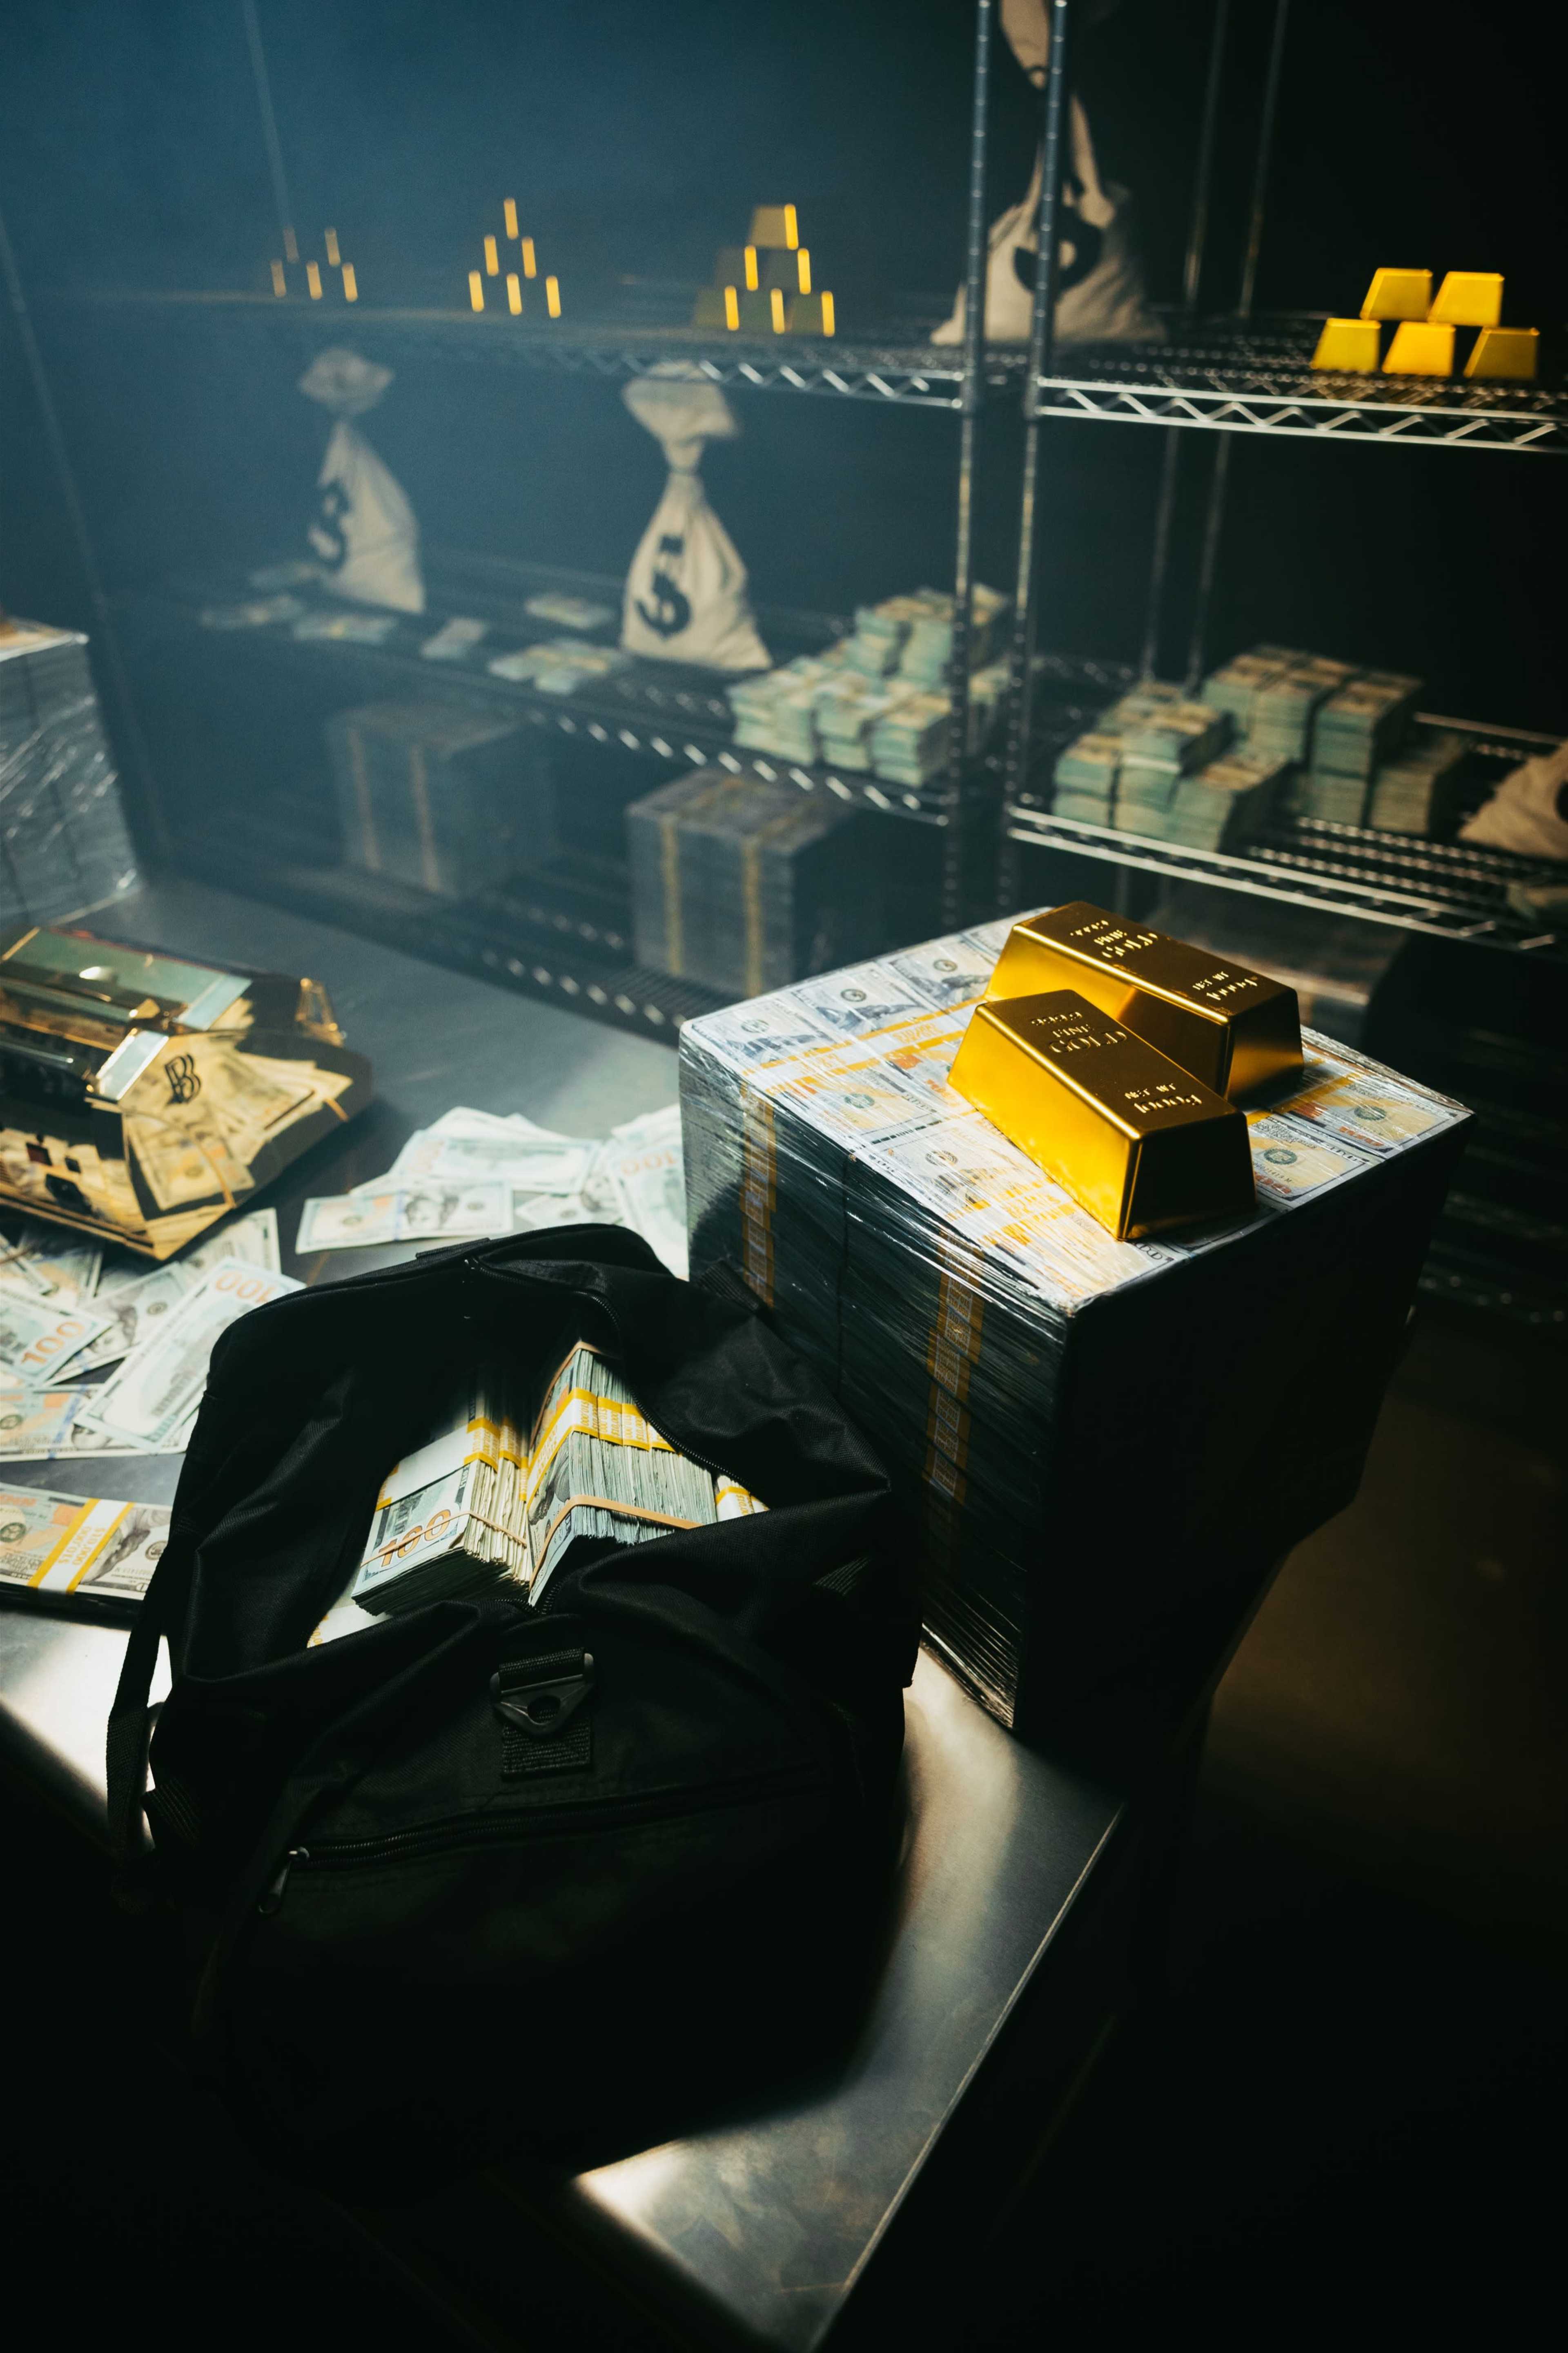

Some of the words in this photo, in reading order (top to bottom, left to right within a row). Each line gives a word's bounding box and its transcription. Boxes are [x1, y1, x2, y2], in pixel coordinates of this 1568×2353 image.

[1102, 933, 1158, 958] GOLD
[1049, 1030, 1127, 1053] GOLD
[1052, 1024, 1095, 1038] FINE
[1125, 1088, 1150, 1100] NET
[1156, 1082, 1176, 1092] WT
[1134, 1094, 1202, 1114] 1000g
[20, 1321, 85, 1365] 100
[379, 1509, 451, 1568] 100
